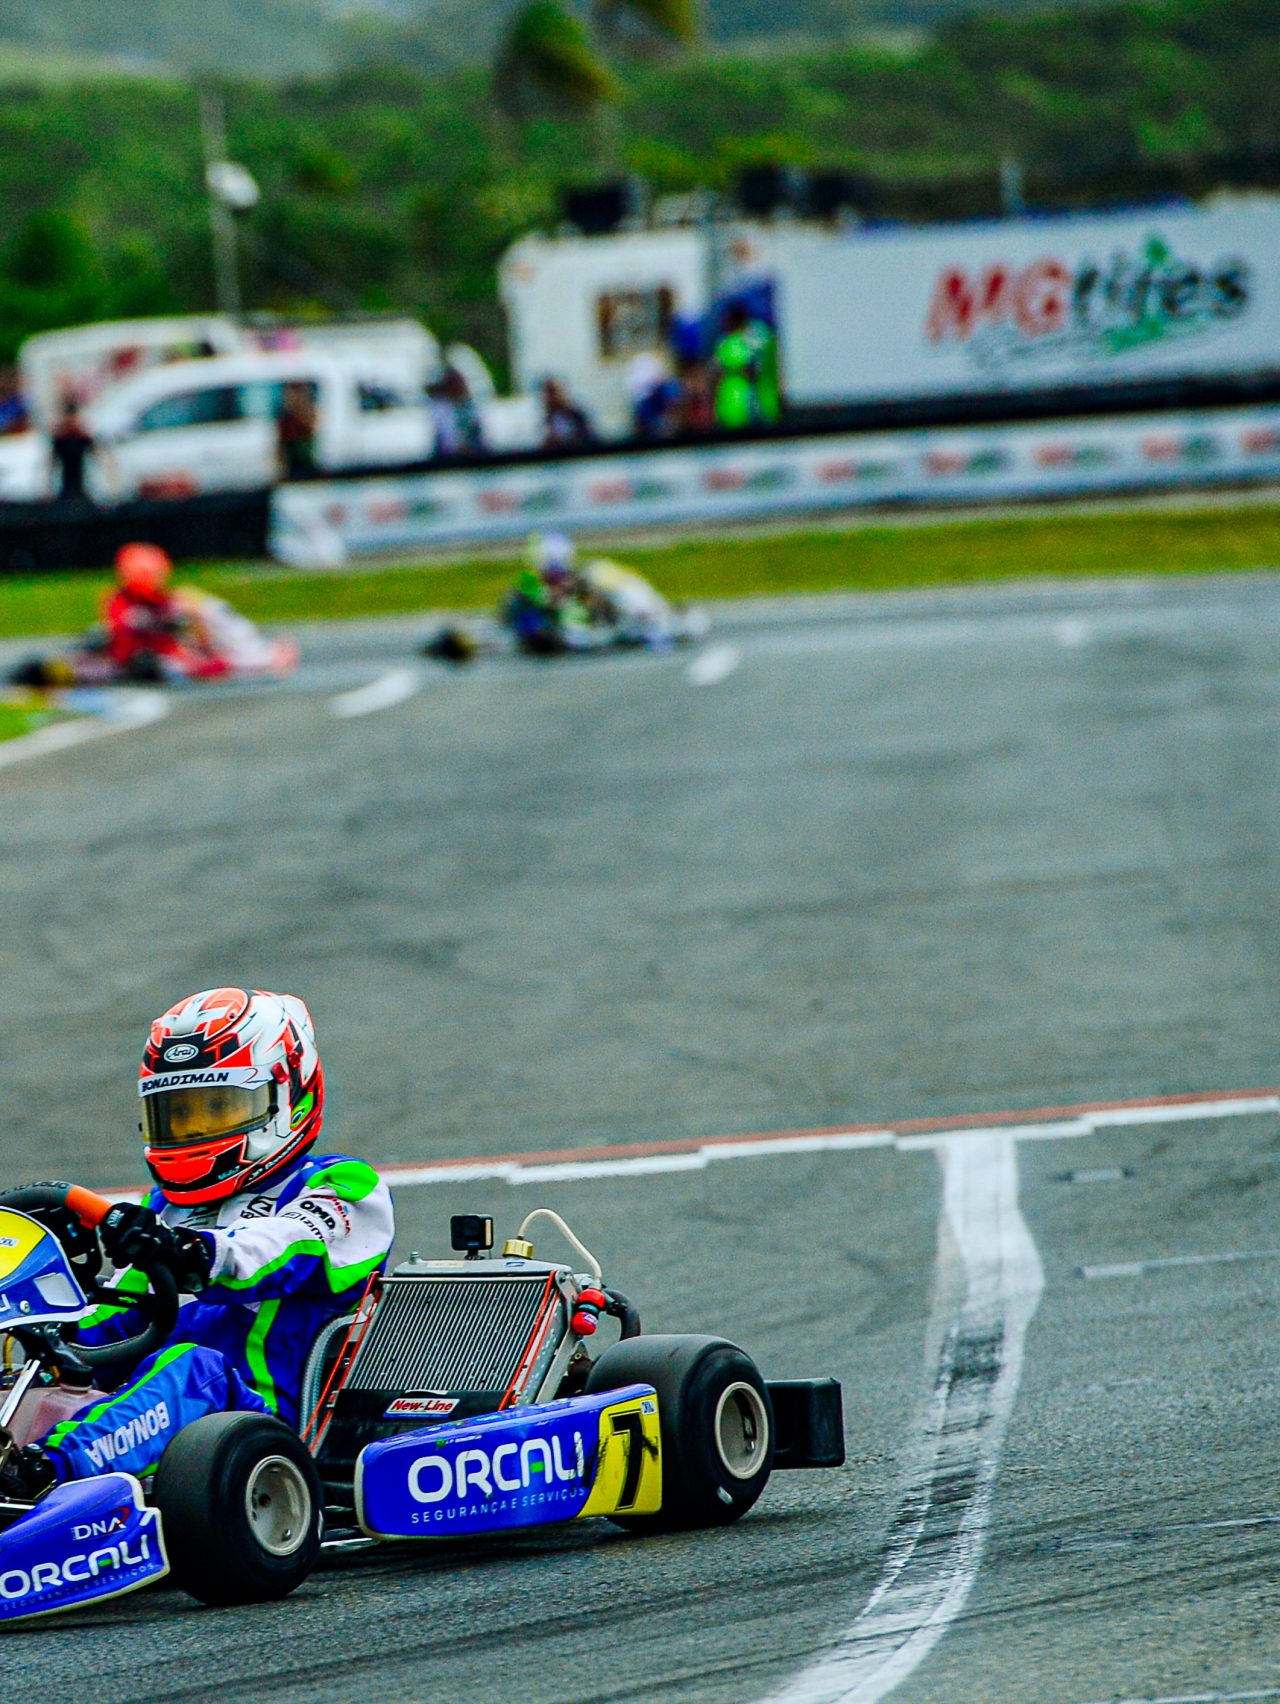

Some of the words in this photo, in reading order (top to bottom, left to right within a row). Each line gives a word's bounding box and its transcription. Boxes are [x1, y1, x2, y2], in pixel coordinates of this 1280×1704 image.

[142, 1072, 229, 1092] BONADIMAN
[391, 1400, 453, 1411] New-Line
[84, 1401, 170, 1468] BONADIMA
[408, 1431, 584, 1503] ORCALI
[411, 1501, 507, 1524] SEGURANÇA
[73, 1514, 128, 1541] DNA
